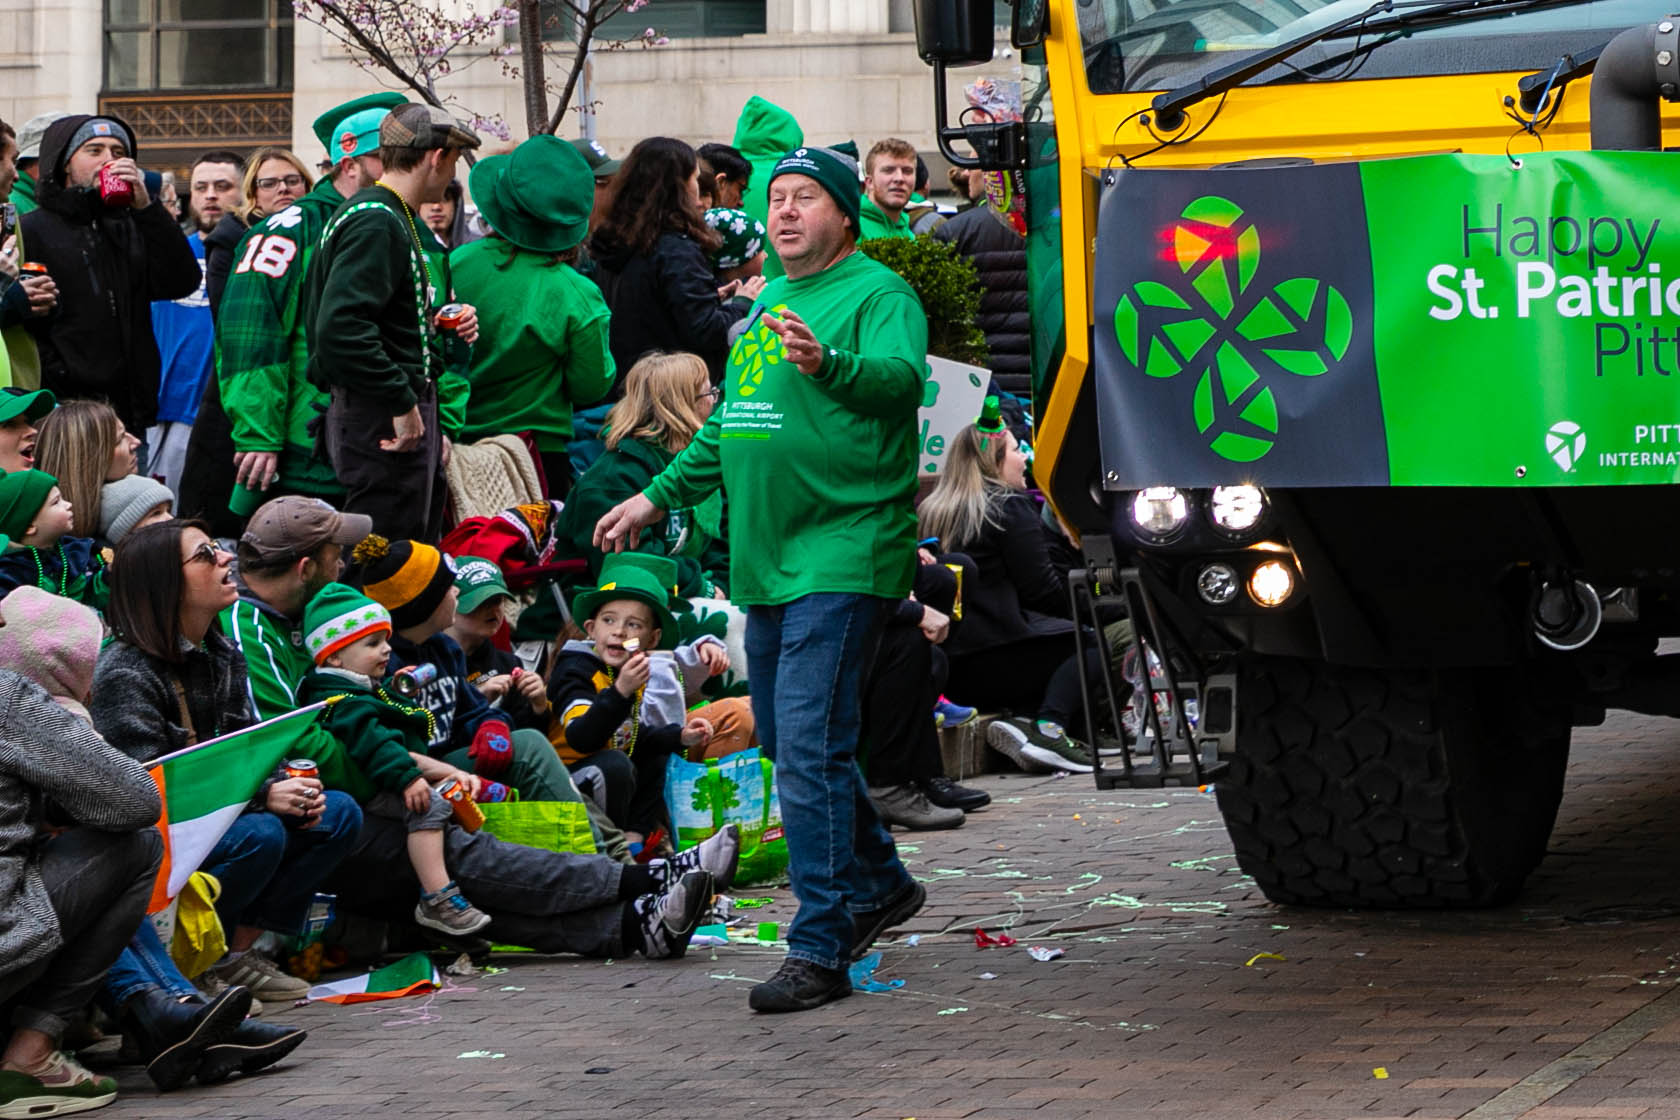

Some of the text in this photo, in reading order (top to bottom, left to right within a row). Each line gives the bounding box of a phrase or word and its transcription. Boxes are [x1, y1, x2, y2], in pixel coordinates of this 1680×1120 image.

[234, 233, 298, 279] 18
[1462, 202, 1661, 272] Happy
[1426, 263, 1499, 321] St.
